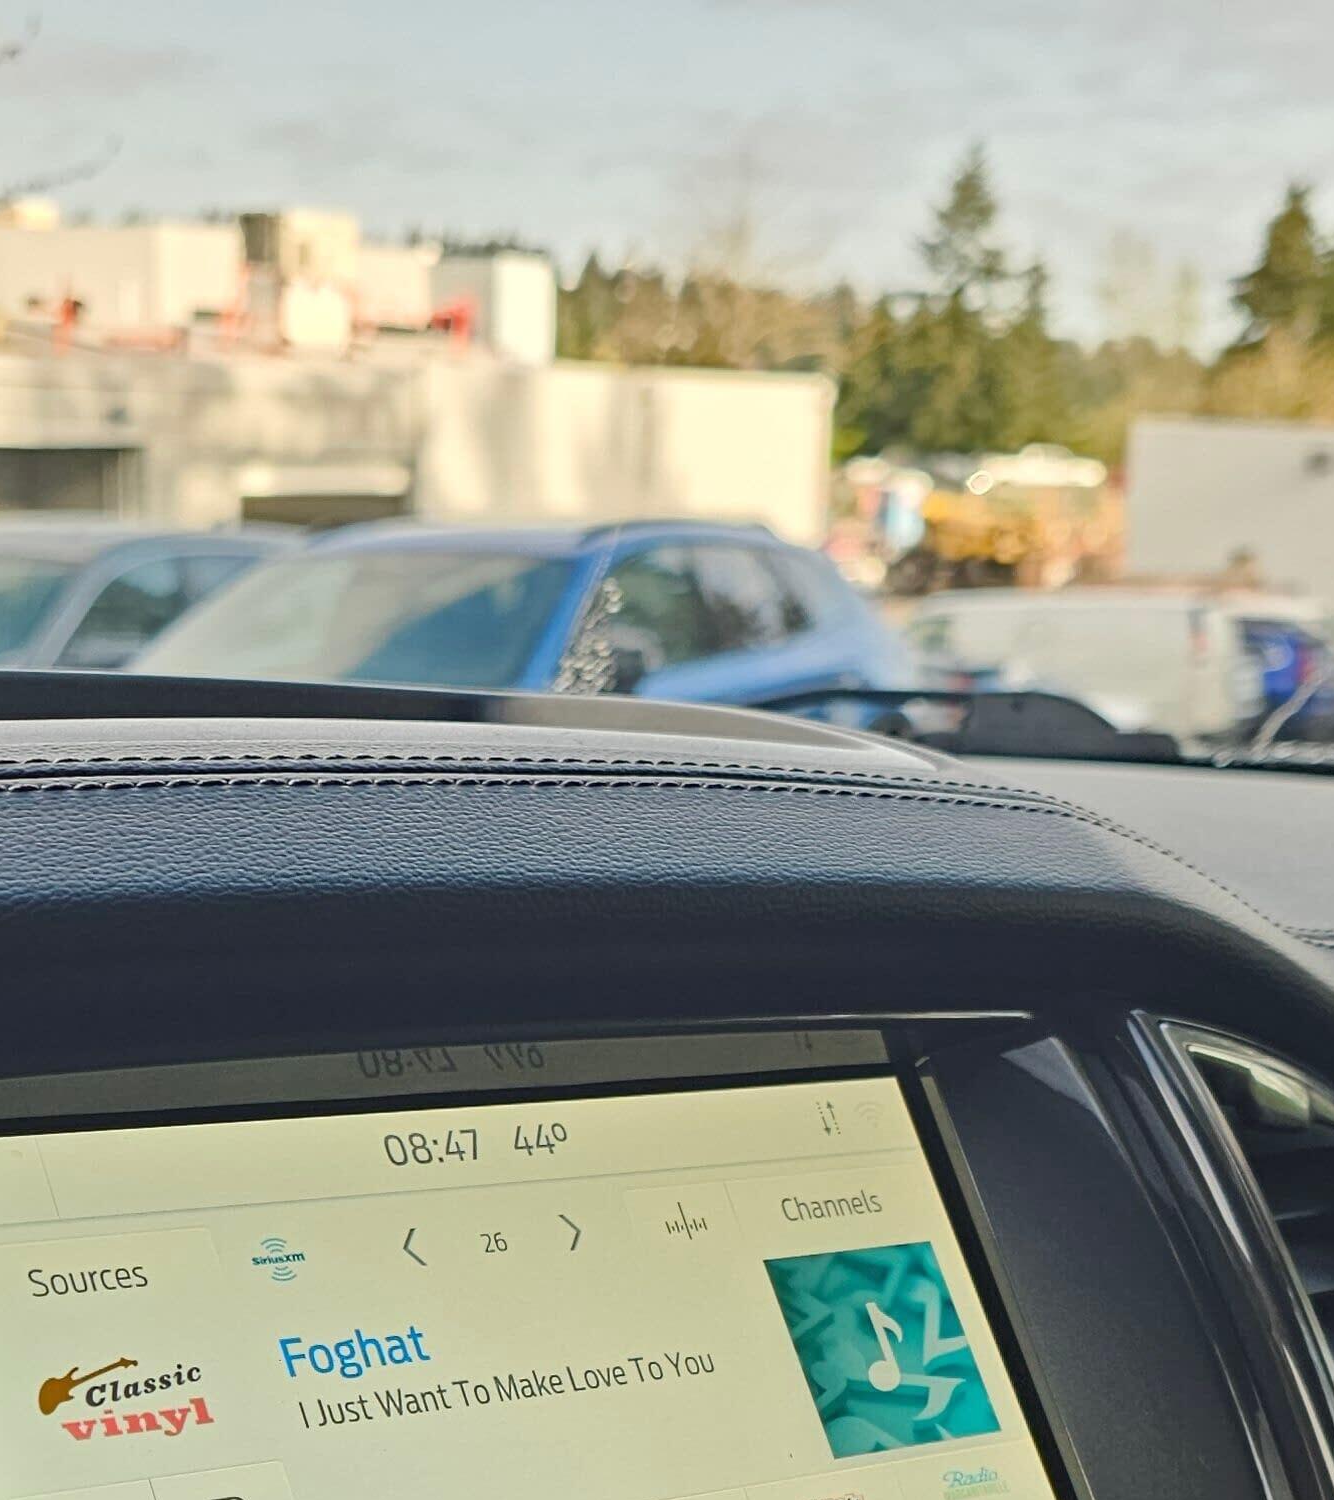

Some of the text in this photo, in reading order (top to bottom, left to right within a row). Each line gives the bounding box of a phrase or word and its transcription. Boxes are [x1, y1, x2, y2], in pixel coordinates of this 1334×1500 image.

[384, 1128, 478, 1166] 08:47
[781, 1189, 883, 1222] Channels
[480, 1232, 508, 1253] 26
[28, 1265, 148, 1297] Sources
[278, 1325, 431, 1379] Foghat
[85, 1363, 202, 1408] Classic
[298, 1352, 716, 1429] I Just Want To Make Love To You
[61, 1397, 215, 1441] vinyl
[942, 1467, 999, 1489] Radio
